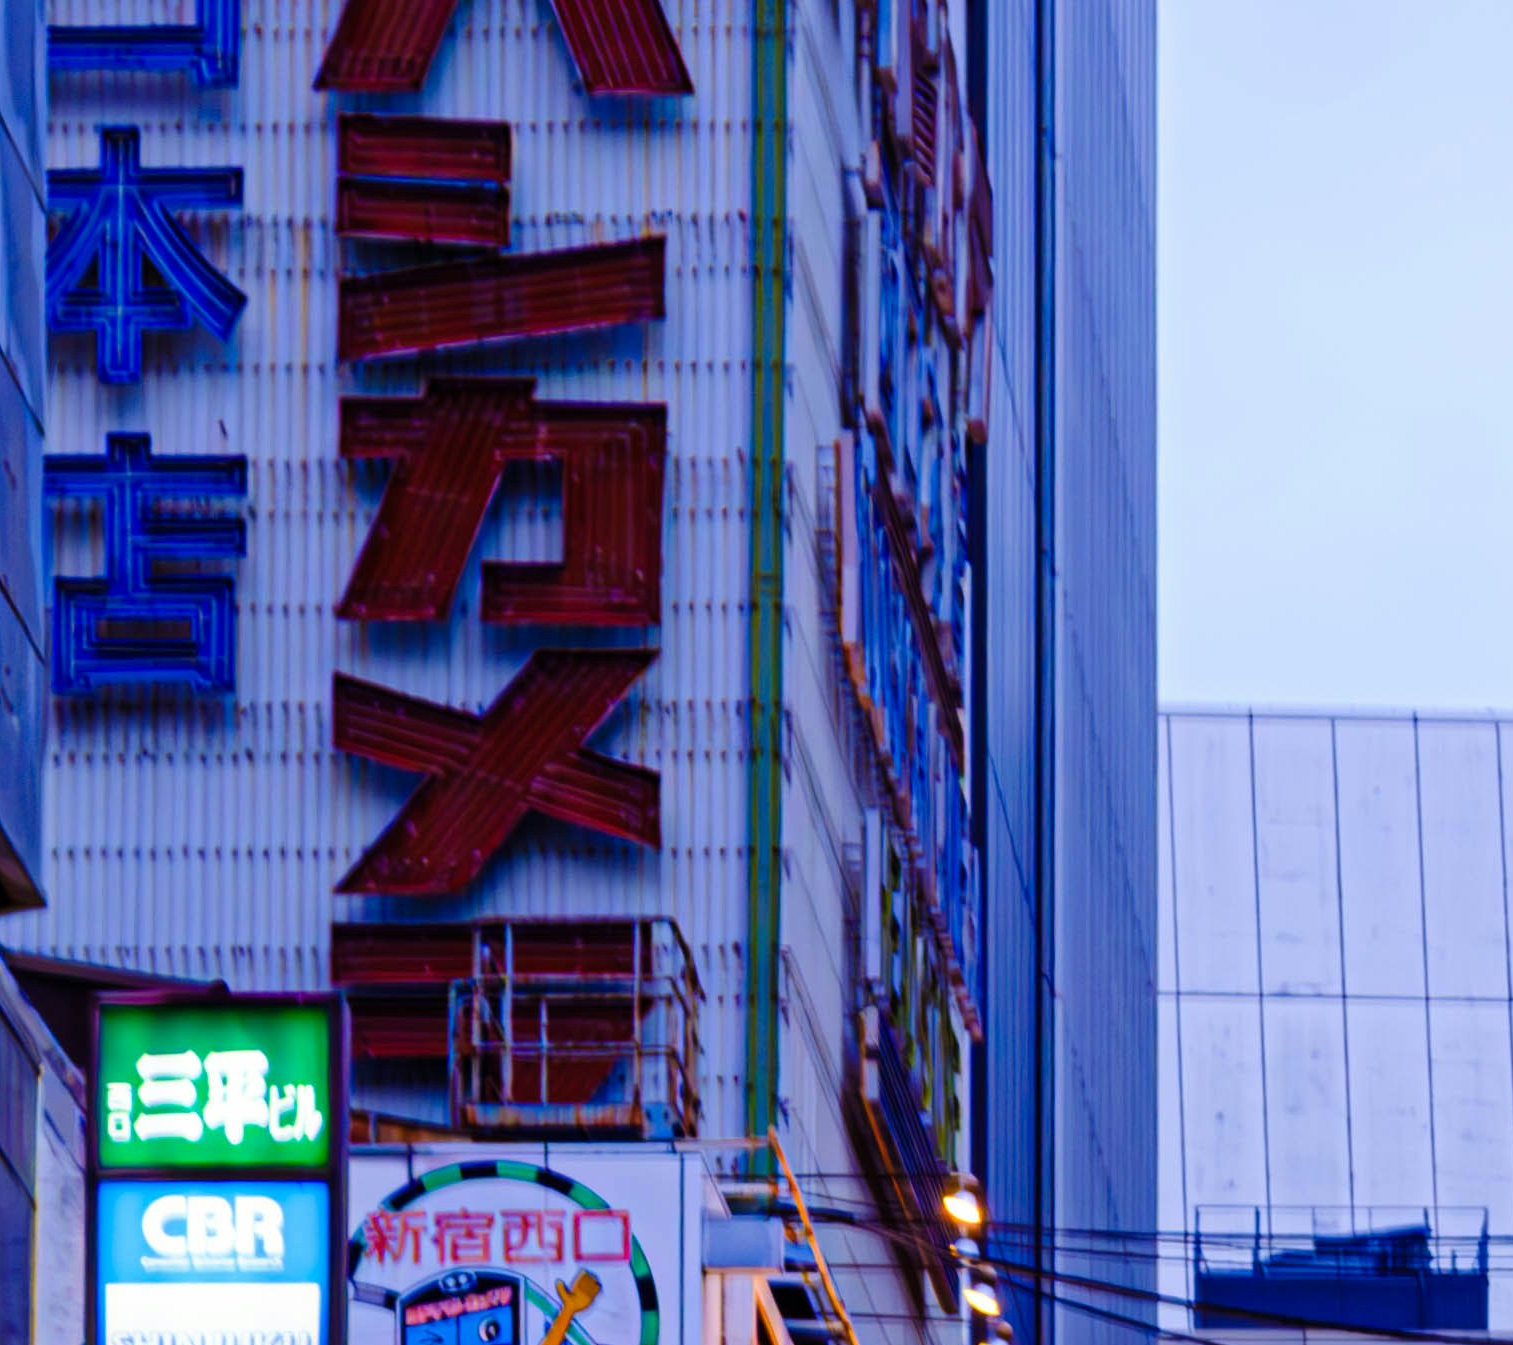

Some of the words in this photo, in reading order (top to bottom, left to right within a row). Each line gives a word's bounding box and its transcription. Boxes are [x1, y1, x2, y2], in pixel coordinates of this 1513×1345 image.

[141, 1194, 284, 1258] CBR
[364, 1207, 631, 1264] 新宿西口
